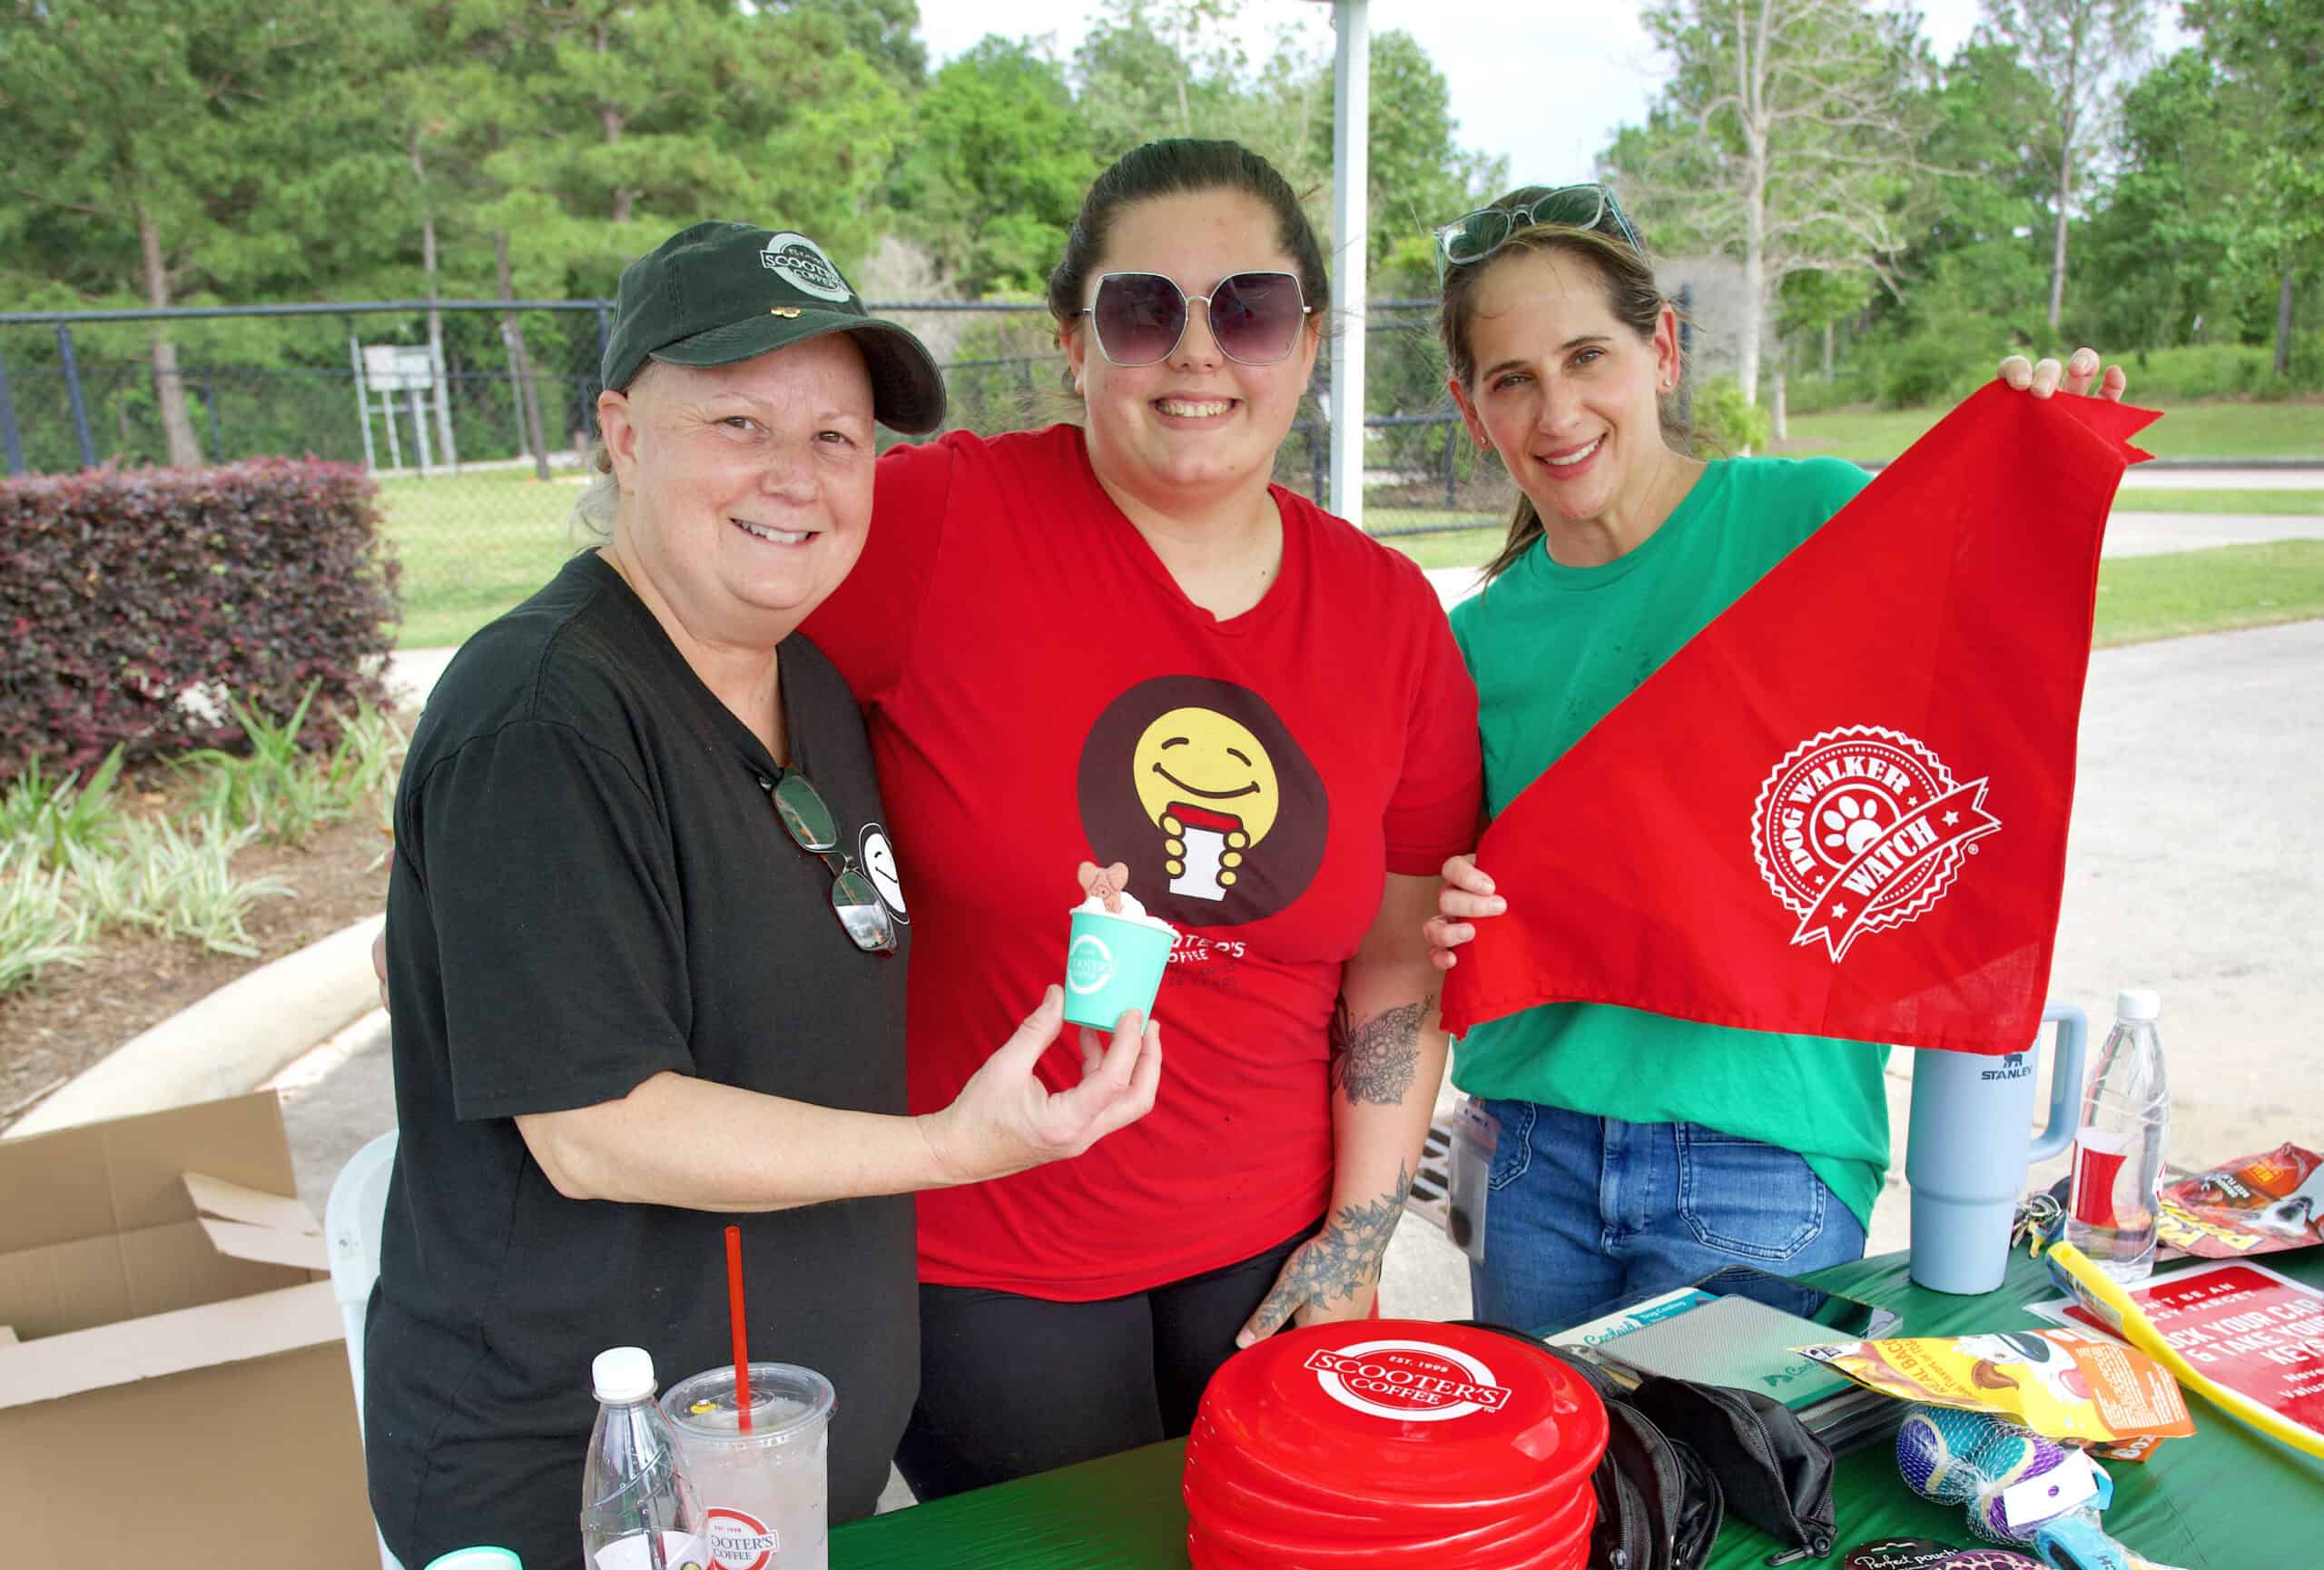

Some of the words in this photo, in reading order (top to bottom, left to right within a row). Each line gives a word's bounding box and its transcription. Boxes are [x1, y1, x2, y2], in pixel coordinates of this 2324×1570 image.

[1788, 755, 1911, 805] WALKER
[1781, 807, 1817, 876] DOG
[1841, 815, 1939, 897] WATCH
[1168, 949, 1209, 963] OFFEE
[1981, 1065, 2034, 1081] STANLEY
[2179, 1290, 2206, 1301] BE
[2209, 1282, 2237, 1294] AN
[2163, 1327, 2216, 1350] OCK
[2201, 1311, 2279, 1336] YOUR
[2206, 1331, 2285, 1357] TAKE
[1419, 1362, 1450, 1373] 1998
[1315, 1355, 1500, 1405] SCOOTER'S
[1350, 1377, 1443, 1406] COFFEE
[711, 1535, 774, 1552] OOTER'S
[713, 1546, 753, 1561] COFFEE
[1914, 1548, 1955, 1564] pouch
